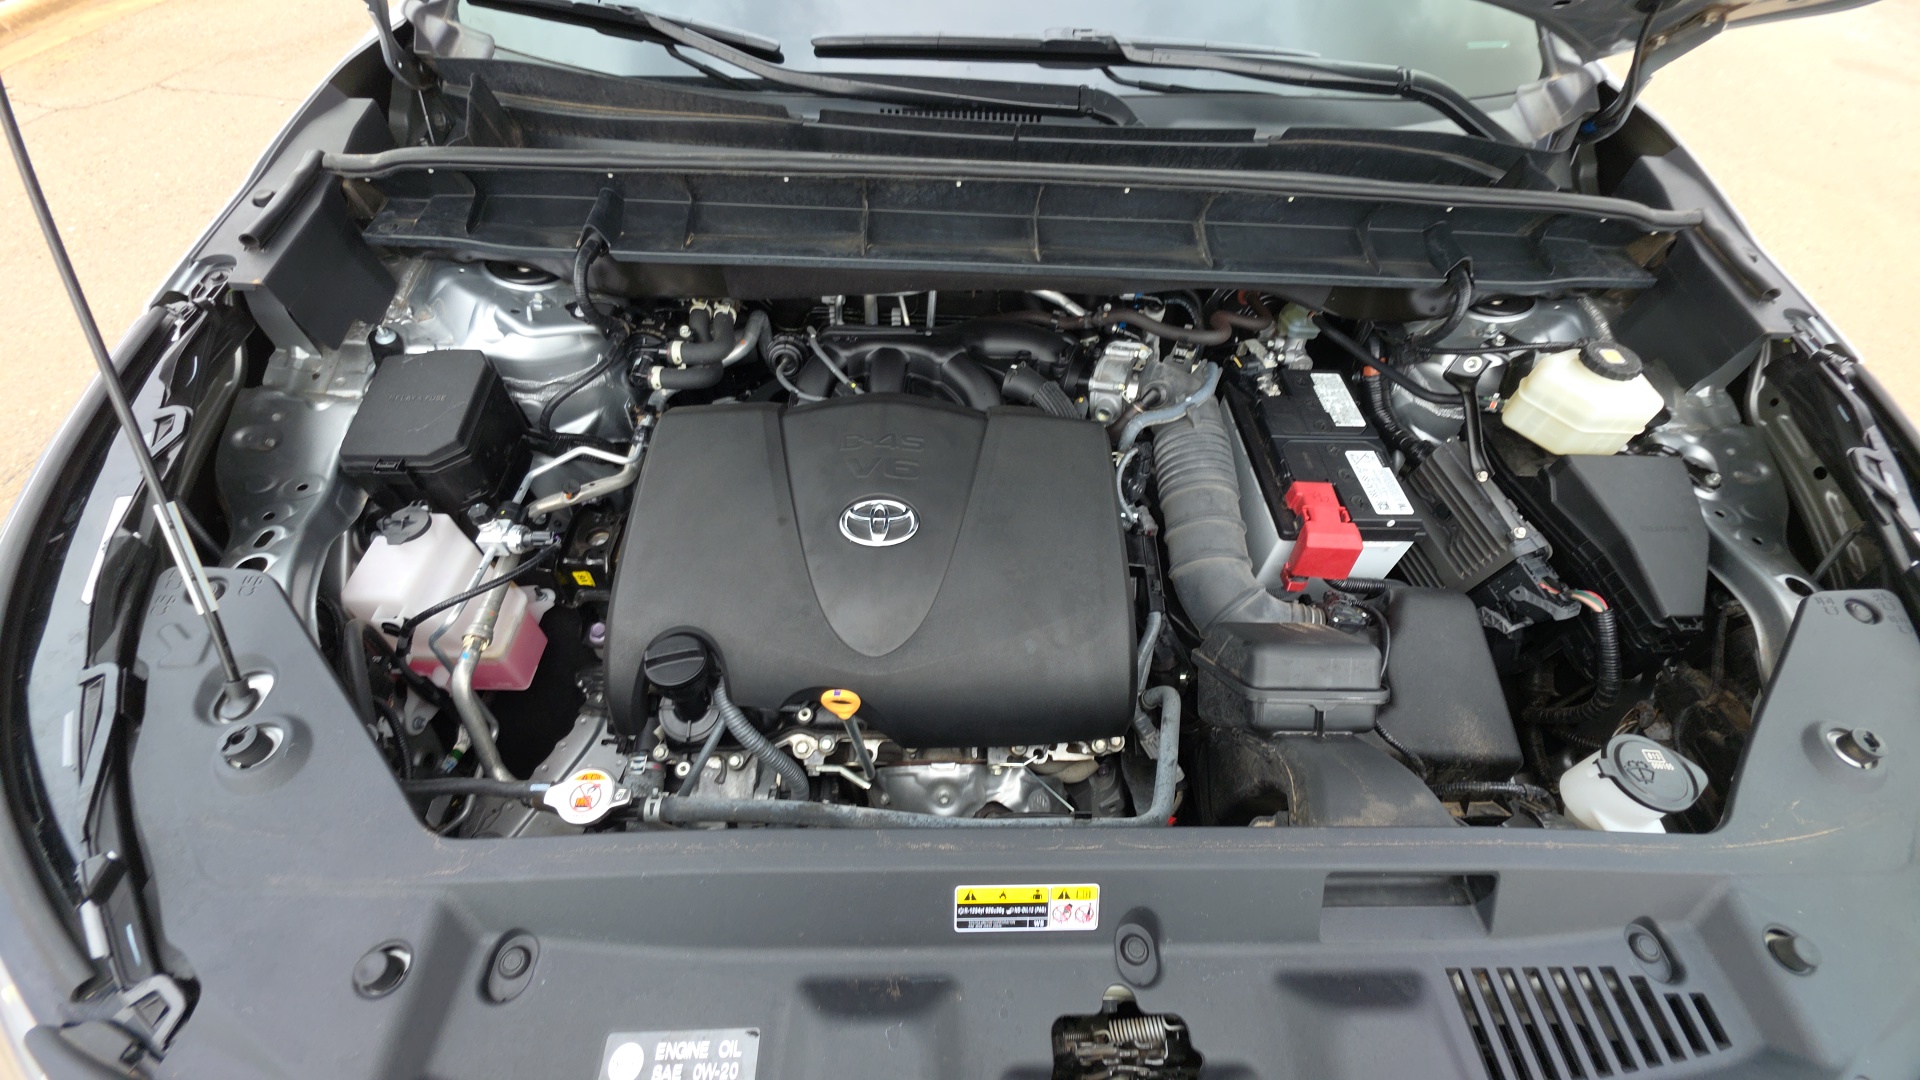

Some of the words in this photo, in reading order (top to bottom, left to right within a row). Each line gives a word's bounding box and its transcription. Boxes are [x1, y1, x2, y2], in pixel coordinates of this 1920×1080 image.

[843, 457, 920, 480] V6
[654, 1041, 710, 1061] ENGINE
[718, 1039, 742, 1058] OIL
[651, 1063, 683, 1080] SAE
[692, 1061, 739, 1080] 0W-20
